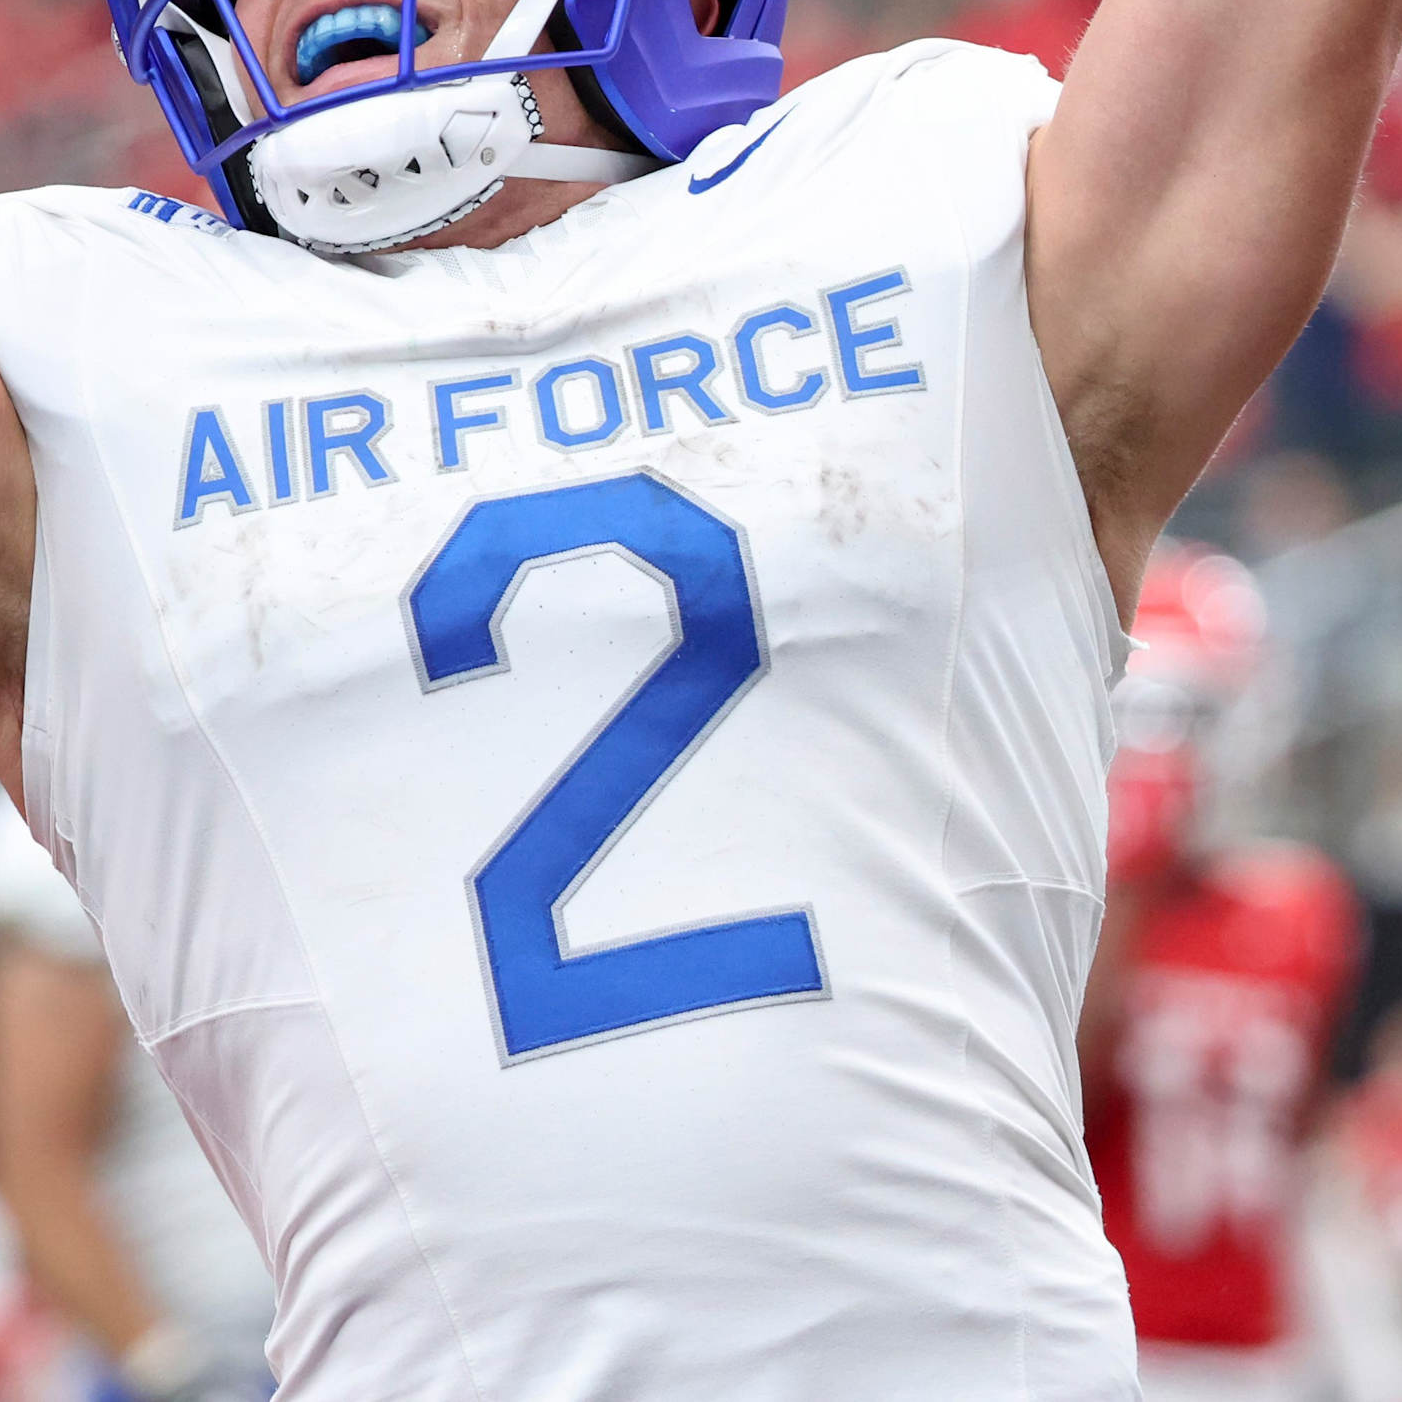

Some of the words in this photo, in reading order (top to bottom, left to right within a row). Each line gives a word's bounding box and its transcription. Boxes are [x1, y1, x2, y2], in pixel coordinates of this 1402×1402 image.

[173, 387, 401, 530] AIR
[428, 264, 928, 474] FORCE
[398, 465, 833, 1069] 2
